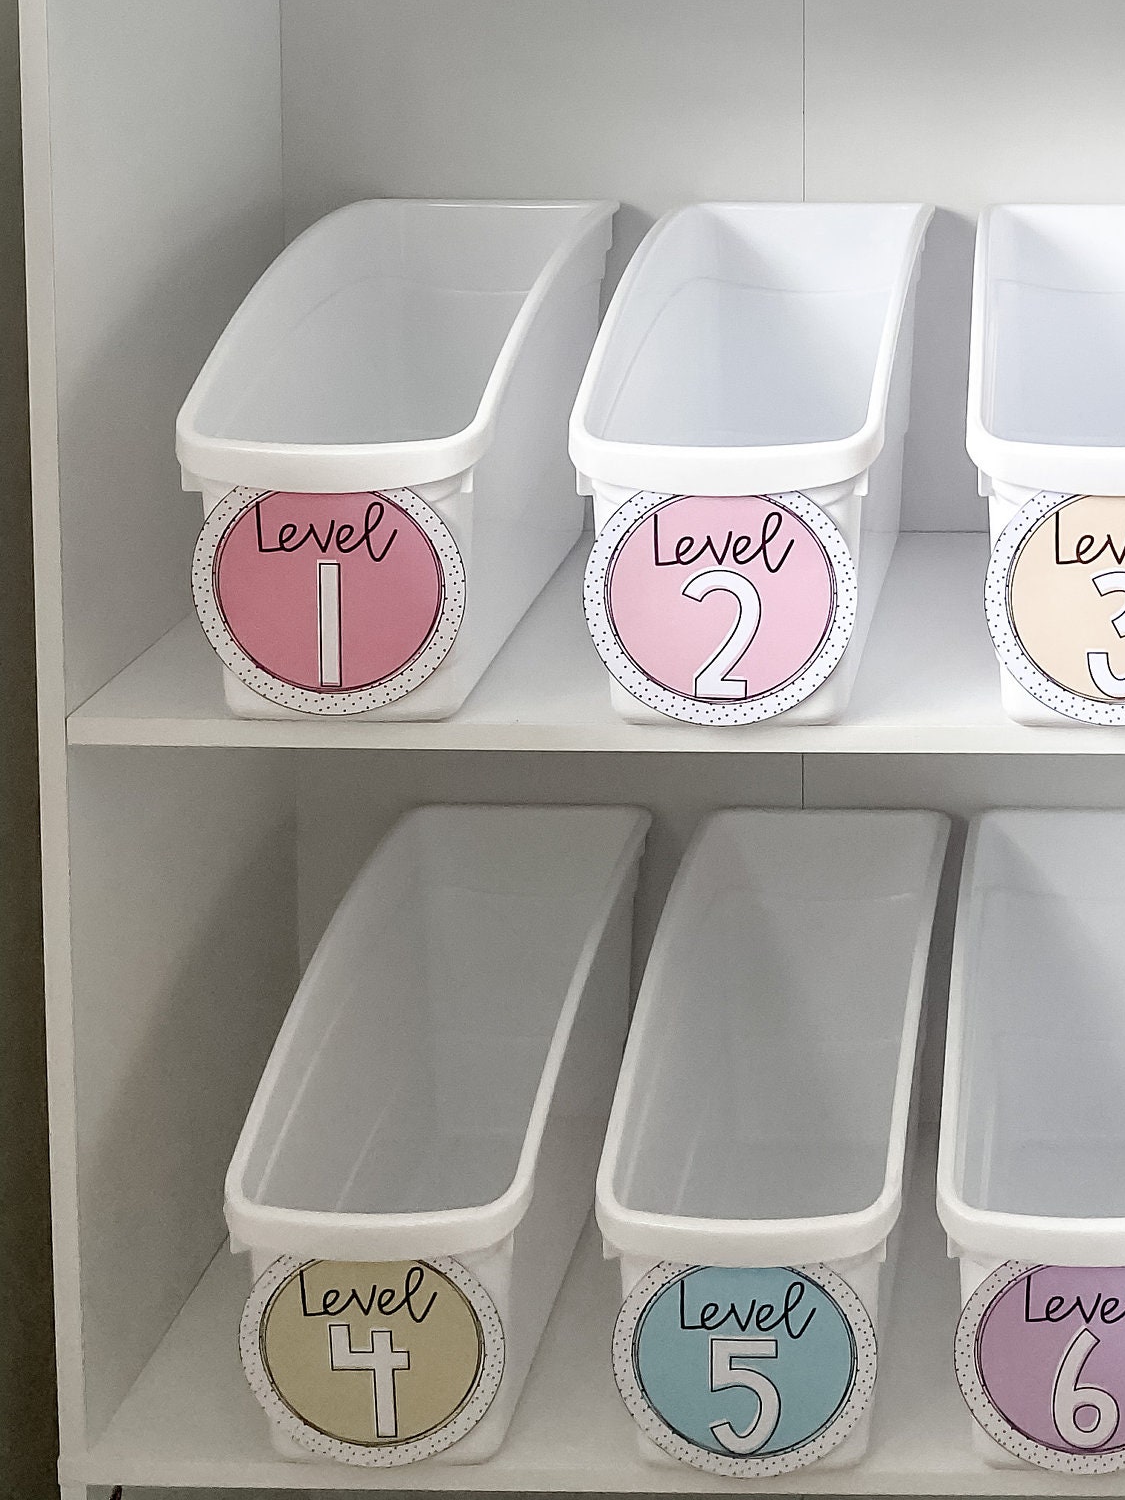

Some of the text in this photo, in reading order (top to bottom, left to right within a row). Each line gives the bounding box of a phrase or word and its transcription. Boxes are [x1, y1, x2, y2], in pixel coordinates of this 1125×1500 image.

[255, 501, 397, 562] Level
[653, 511, 795, 573] Level
[681, 569, 762, 700] 2
[299, 1267, 437, 1323] Level
[679, 1281, 817, 1339] Level
[328, 1324, 410, 1439] 4
[708, 1338, 781, 1455] 5
[1052, 1328, 1120, 1450] 6
